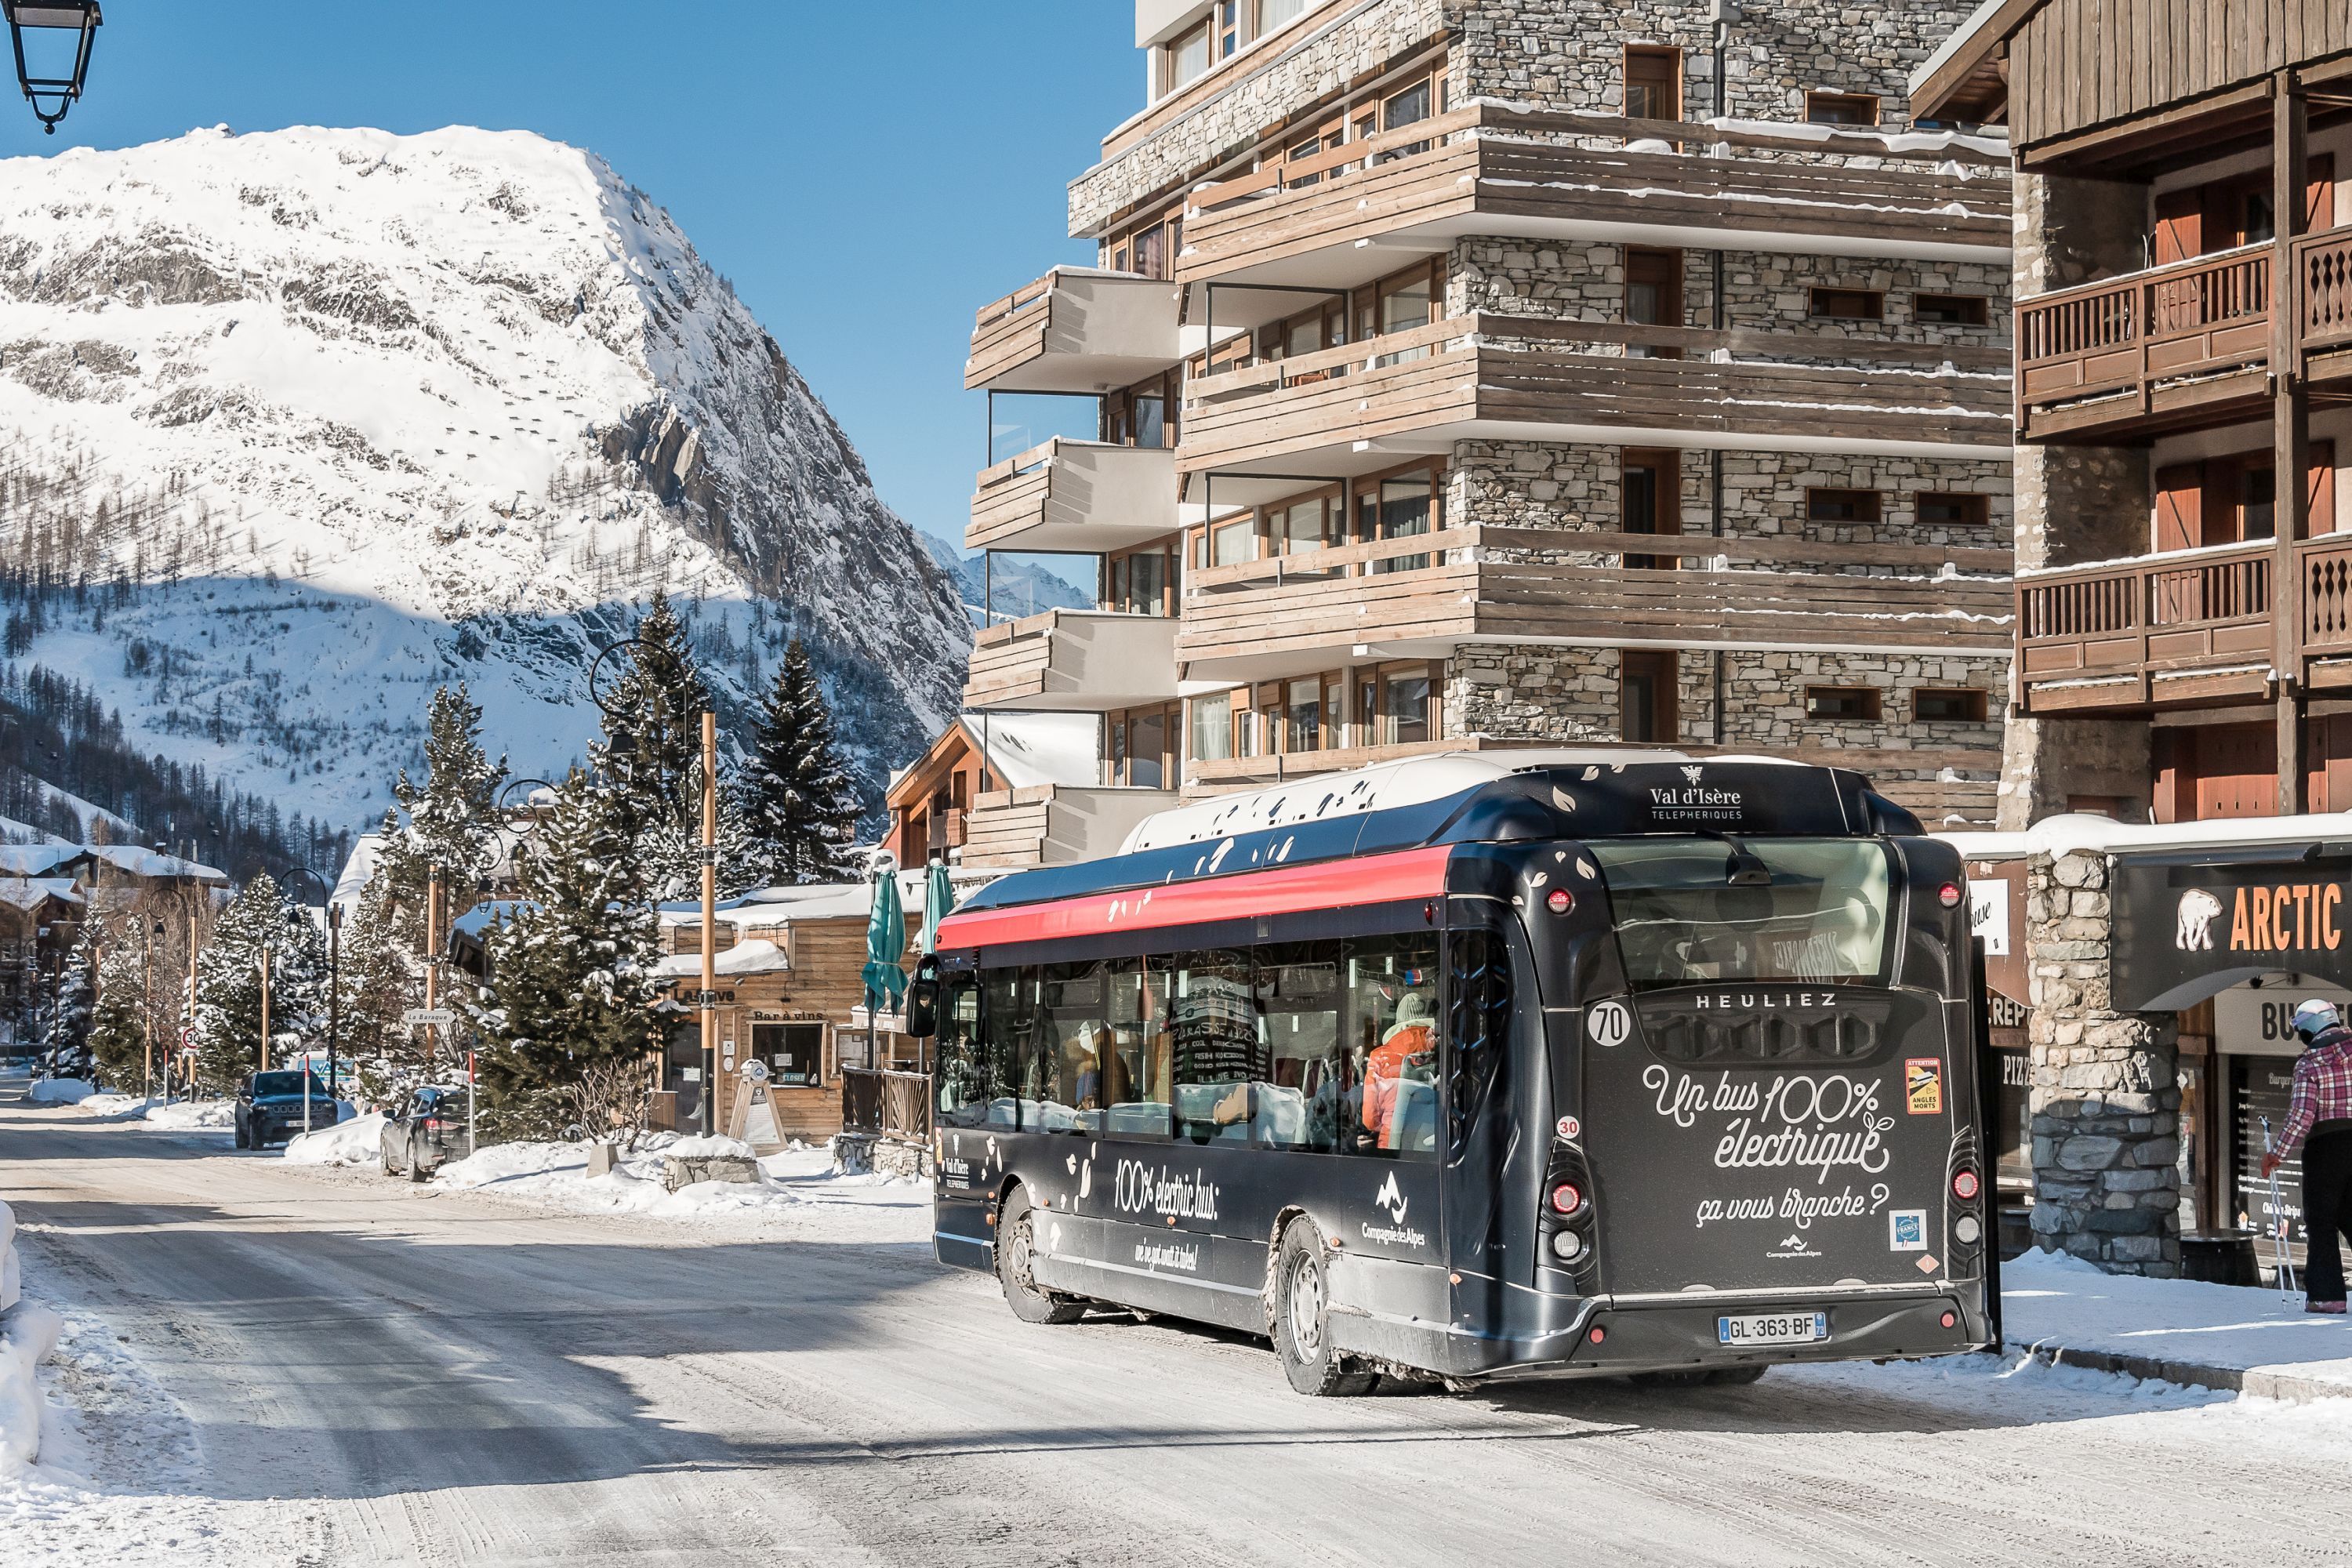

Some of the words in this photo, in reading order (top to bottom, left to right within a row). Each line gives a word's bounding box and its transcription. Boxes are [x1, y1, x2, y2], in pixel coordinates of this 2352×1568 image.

[1649, 788, 1679, 804] Val
[1651, 811, 1743, 819] TELEPHERIQUES
[2230, 883, 2342, 951] ARCTIC
[1696, 993, 1836, 1009] HEULIEZ
[1987, 997, 2033, 1026] REP
[753, 1011, 779, 1021] Bar
[782, 1010, 791, 1021] à
[793, 1011, 823, 1021] vins
[1595, 1007, 1623, 1041] 70
[187, 1033, 200, 1043] 30
[783, 1073, 805, 1082] CLOSED
[1642, 1064, 1708, 1127] Un
[1712, 1070, 1759, 1111] bus
[1761, 1075, 1882, 1124] 100%
[1559, 1121, 1577, 1134] 30
[1714, 1116, 1890, 1185] électrique
[1115, 1158, 1154, 1214] 100%
[1155, 1164, 1195, 1218] electric
[1696, 1200, 1724, 1229] ça
[1726, 1196, 1774, 1220] vous
[1779, 1187, 1865, 1229] branche
[1730, 1317, 1813, 1338] GL-363-BF
